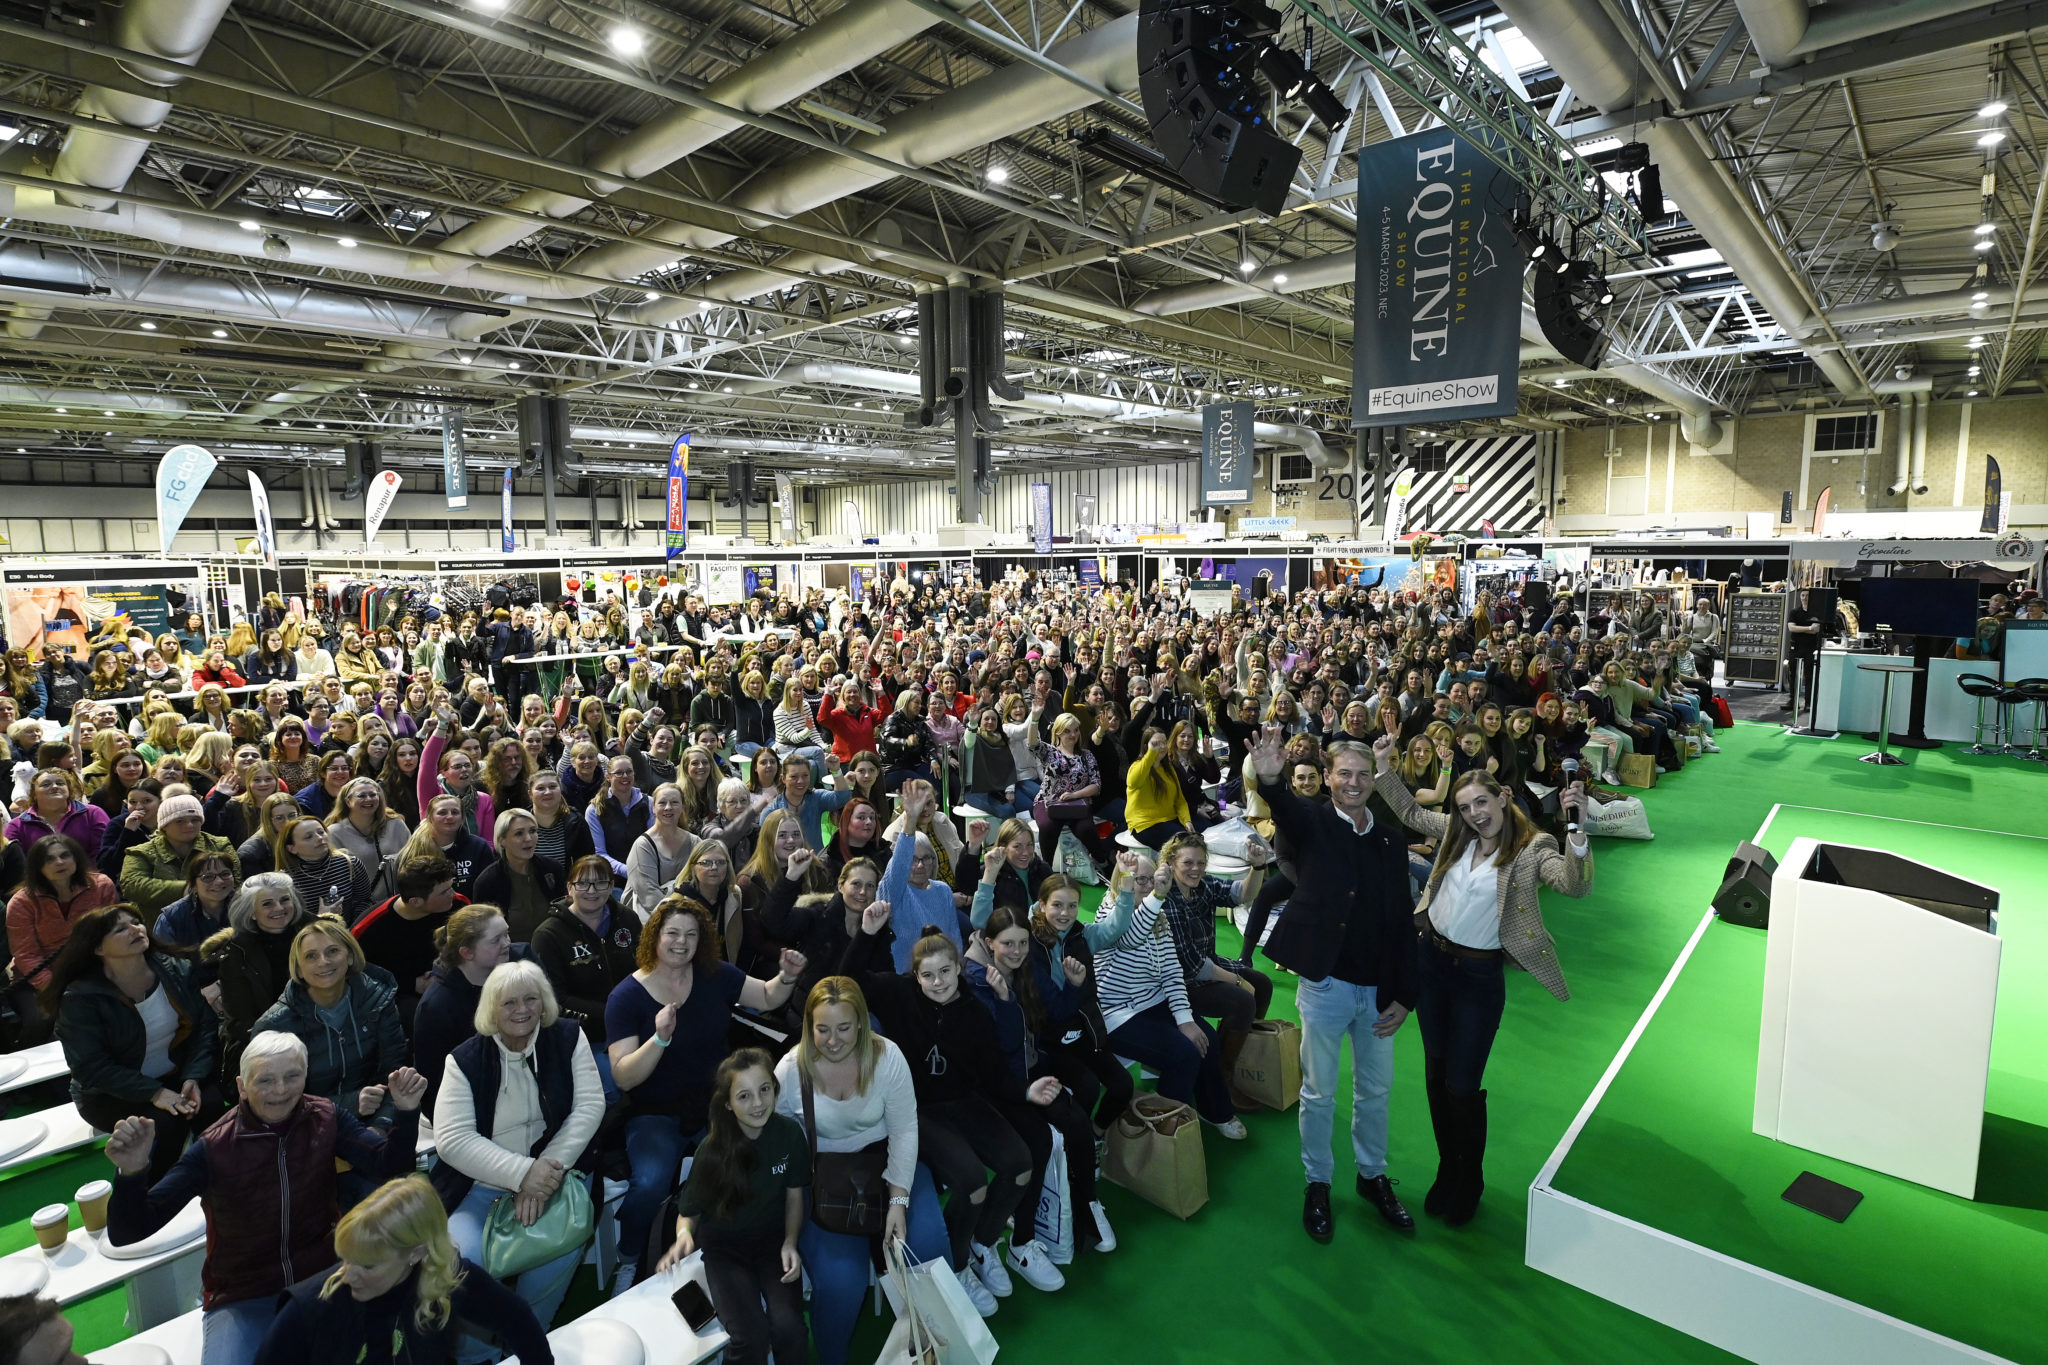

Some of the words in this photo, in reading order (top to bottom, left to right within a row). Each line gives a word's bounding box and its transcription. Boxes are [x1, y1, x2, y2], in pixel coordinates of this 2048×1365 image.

[1459, 168, 1472, 206] THE
[1381, 205, 1391, 224] 4-5
[1379, 226, 1391, 265] MARCH
[1395, 231, 1407, 287] SHOW
[1406, 138, 1455, 362] EQUINE
[1377, 268, 1389, 297] 2023,
[1455, 220, 1470, 325] NATIONAL
[1377, 298, 1388, 319] NEC
[1371, 383, 1495, 409] #EquineShow
[1217, 408, 1233, 483] EQUINE
[165, 449, 200, 502] FGcbd
[1318, 474, 1354, 501] 20
[368, 488, 393, 525] Renapur
[1393, 498, 1406, 541] eglove.co.uk
[1858, 542, 1913, 559] Eqcouture
[572, 944, 592, 959] IX
[1065, 1029, 1083, 1039] NIKE
